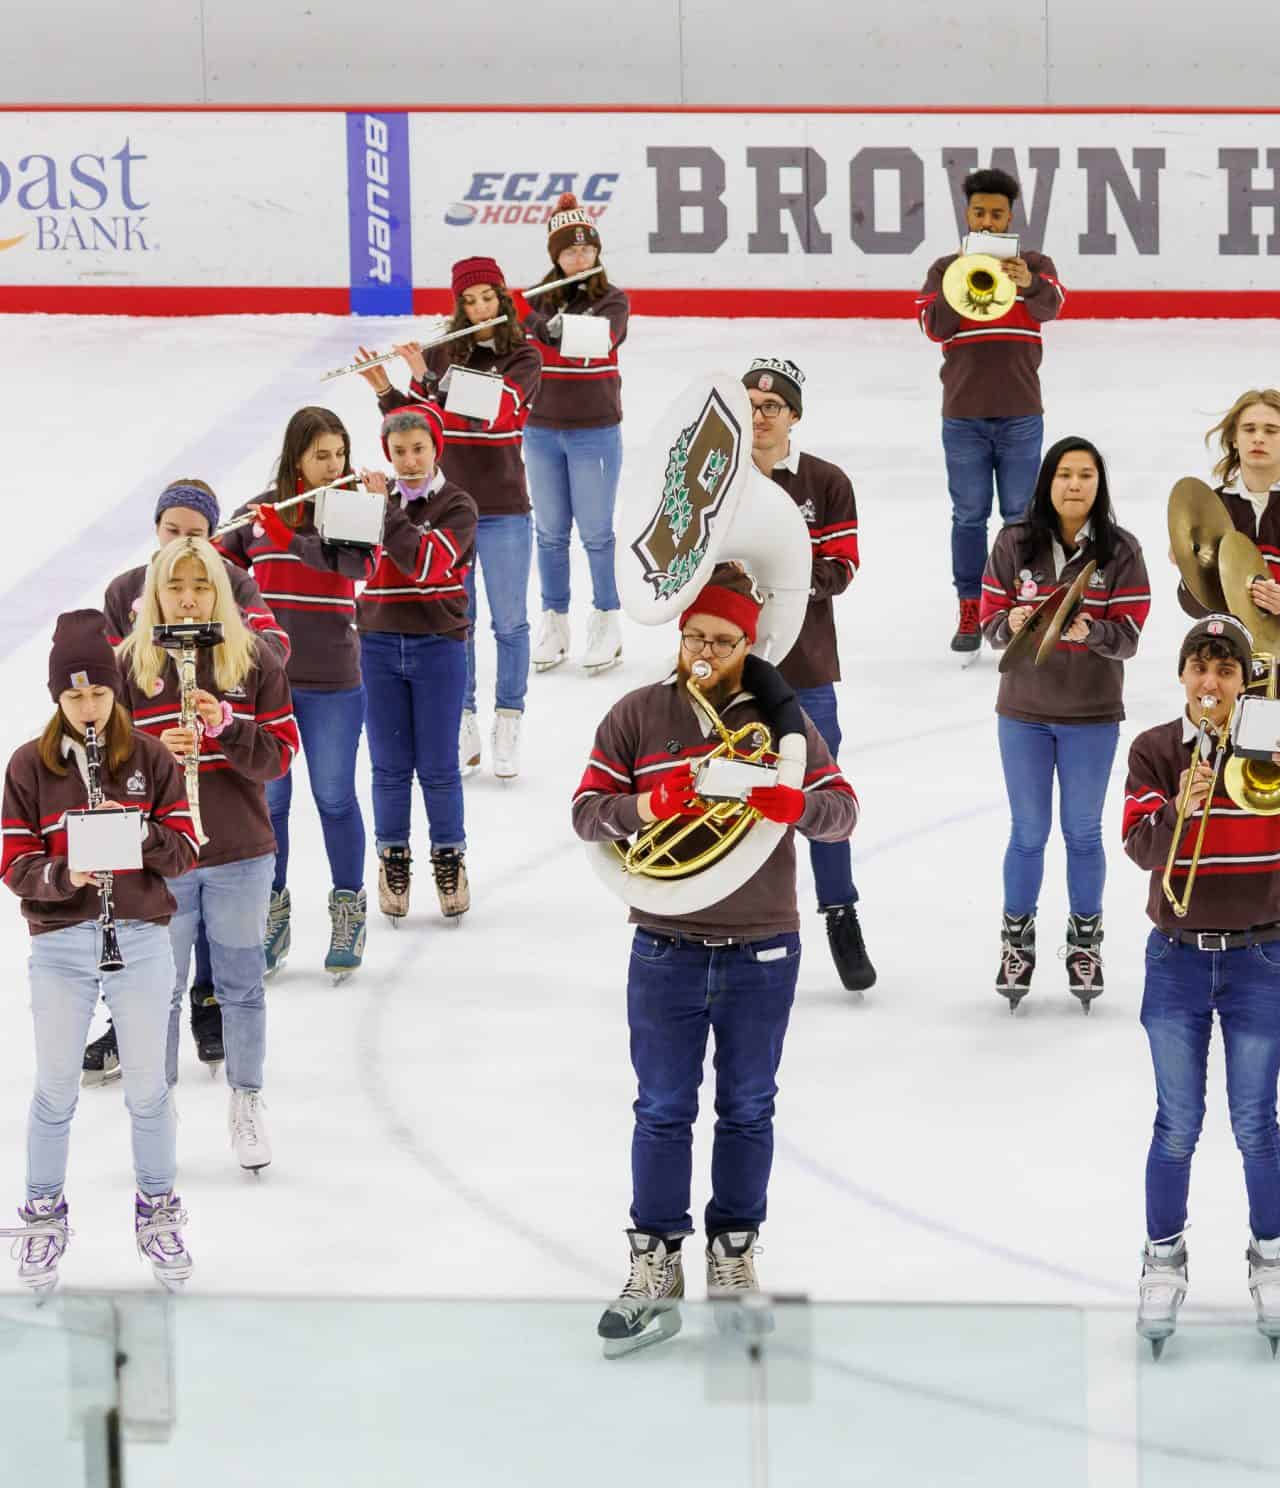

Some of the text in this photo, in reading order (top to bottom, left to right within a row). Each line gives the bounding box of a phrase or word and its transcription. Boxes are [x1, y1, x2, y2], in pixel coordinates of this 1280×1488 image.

[0, 135, 150, 211] ast
[463, 172, 619, 202] ECAC
[480, 204, 608, 225] HOCY
[646, 146, 1166, 255] BROWN
[36, 215, 150, 251] BANK
